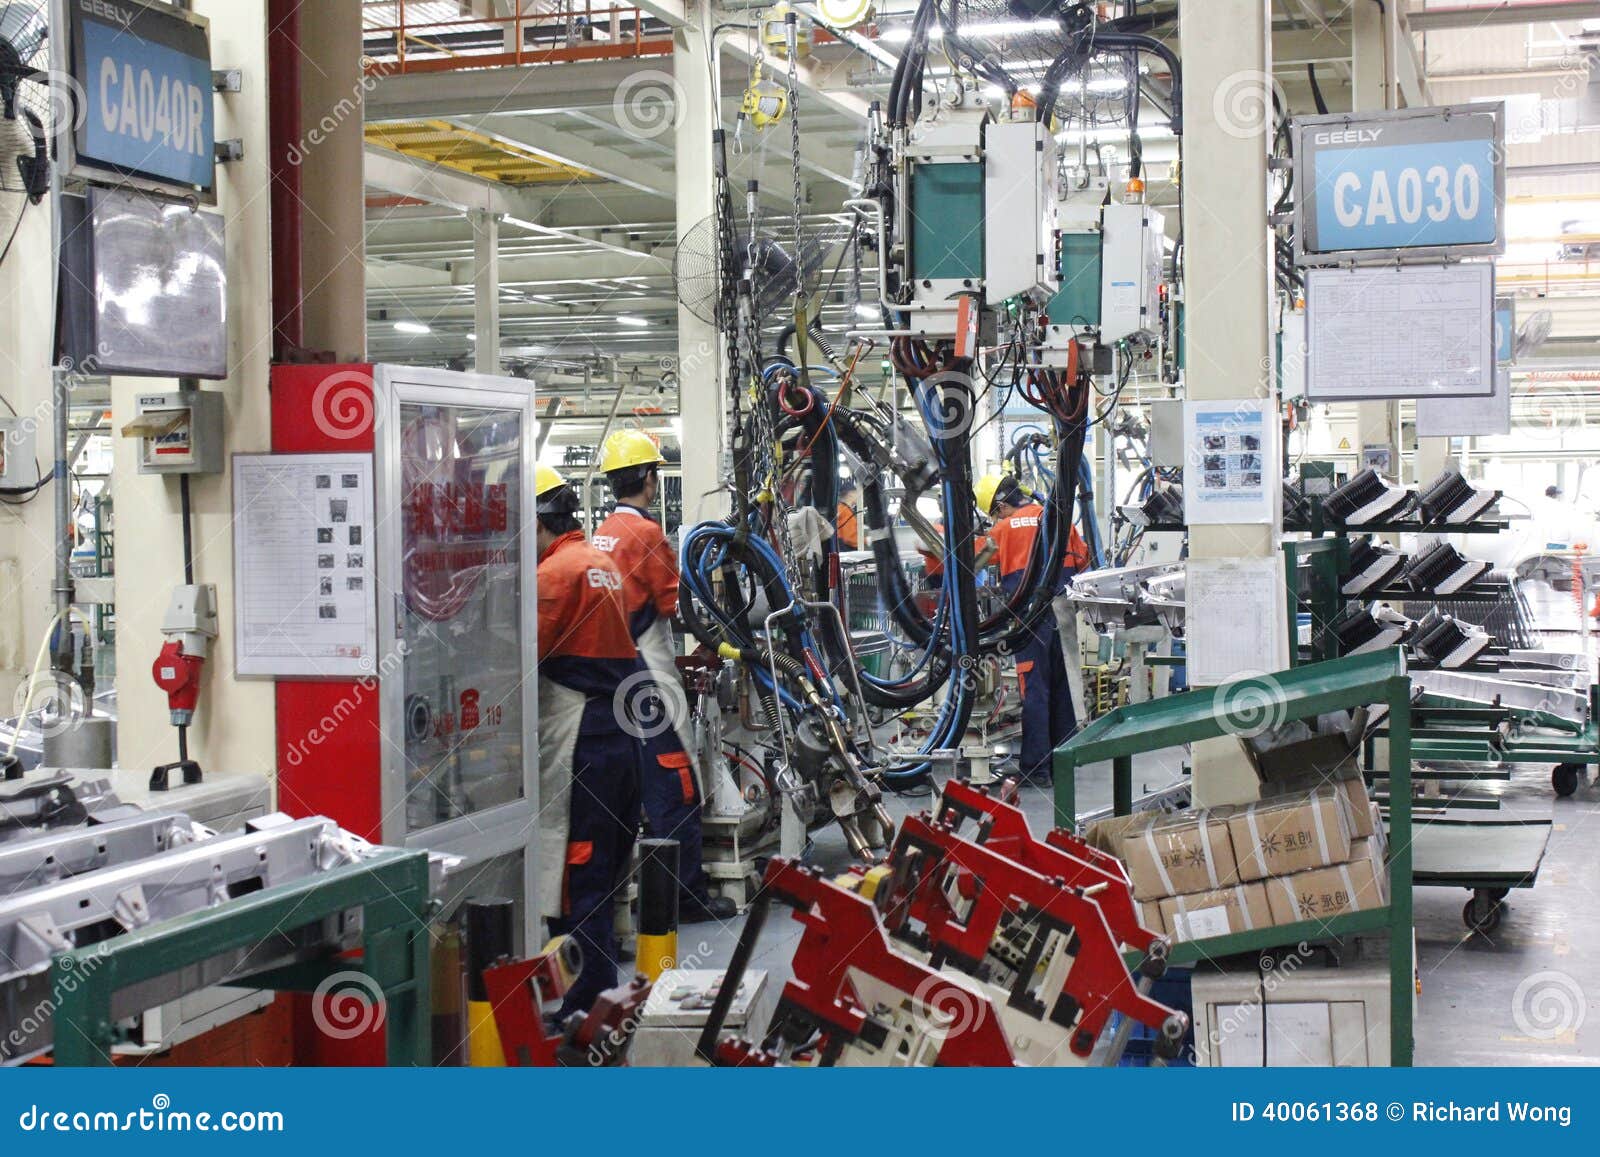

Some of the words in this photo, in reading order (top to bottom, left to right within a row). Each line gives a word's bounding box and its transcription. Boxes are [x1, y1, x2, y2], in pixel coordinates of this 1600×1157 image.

[80, 0, 133, 25] GEELY
[101, 56, 205, 157] CA040R
[1314, 128, 1383, 146] GEELY
[1333, 163, 1480, 228] CA030
[1010, 516, 1039, 529] GEE
[486, 704, 502, 726] 119
